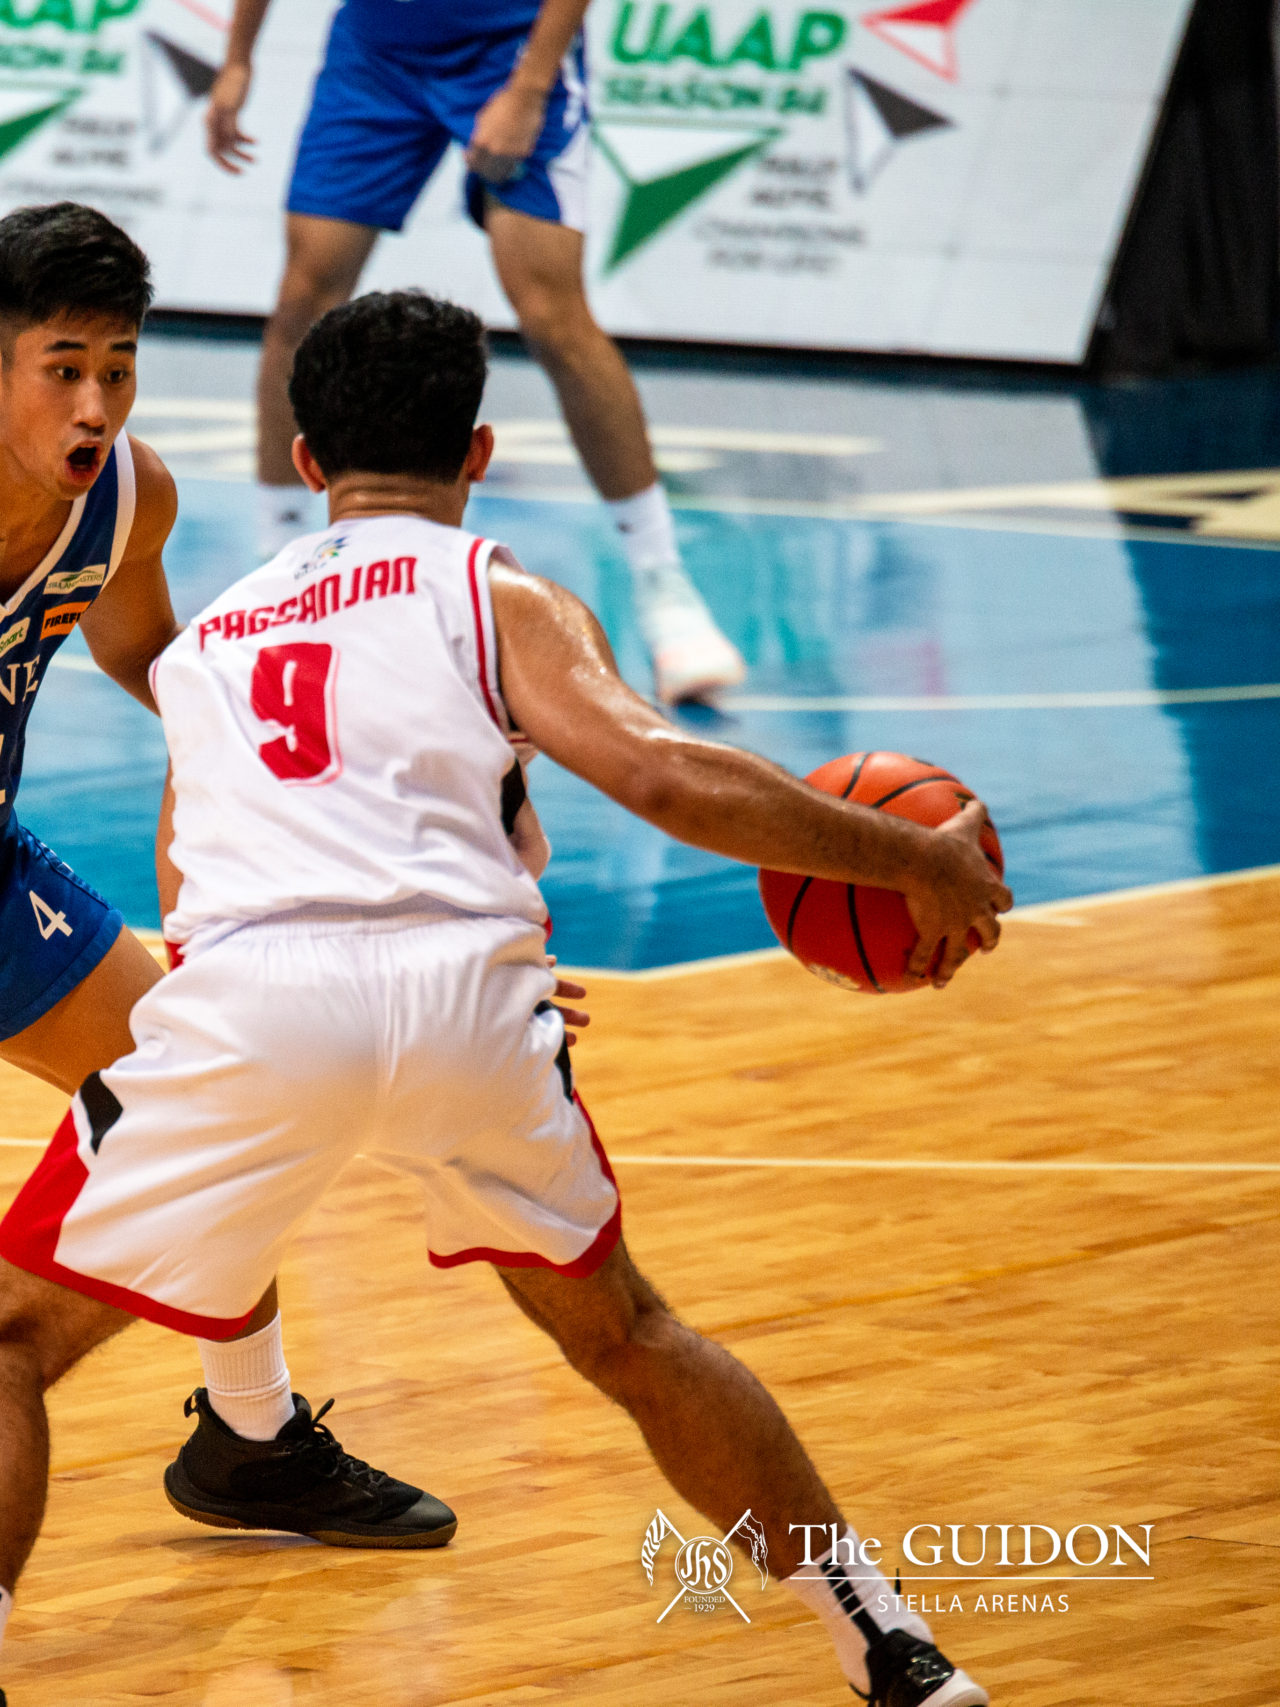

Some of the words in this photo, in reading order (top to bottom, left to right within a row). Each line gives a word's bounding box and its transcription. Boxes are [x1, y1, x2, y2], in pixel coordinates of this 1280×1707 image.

[609, 0, 848, 72] UAAP
[604, 75, 764, 109] SEASON
[250, 641, 343, 787] 9
[28, 889, 73, 940] 4
